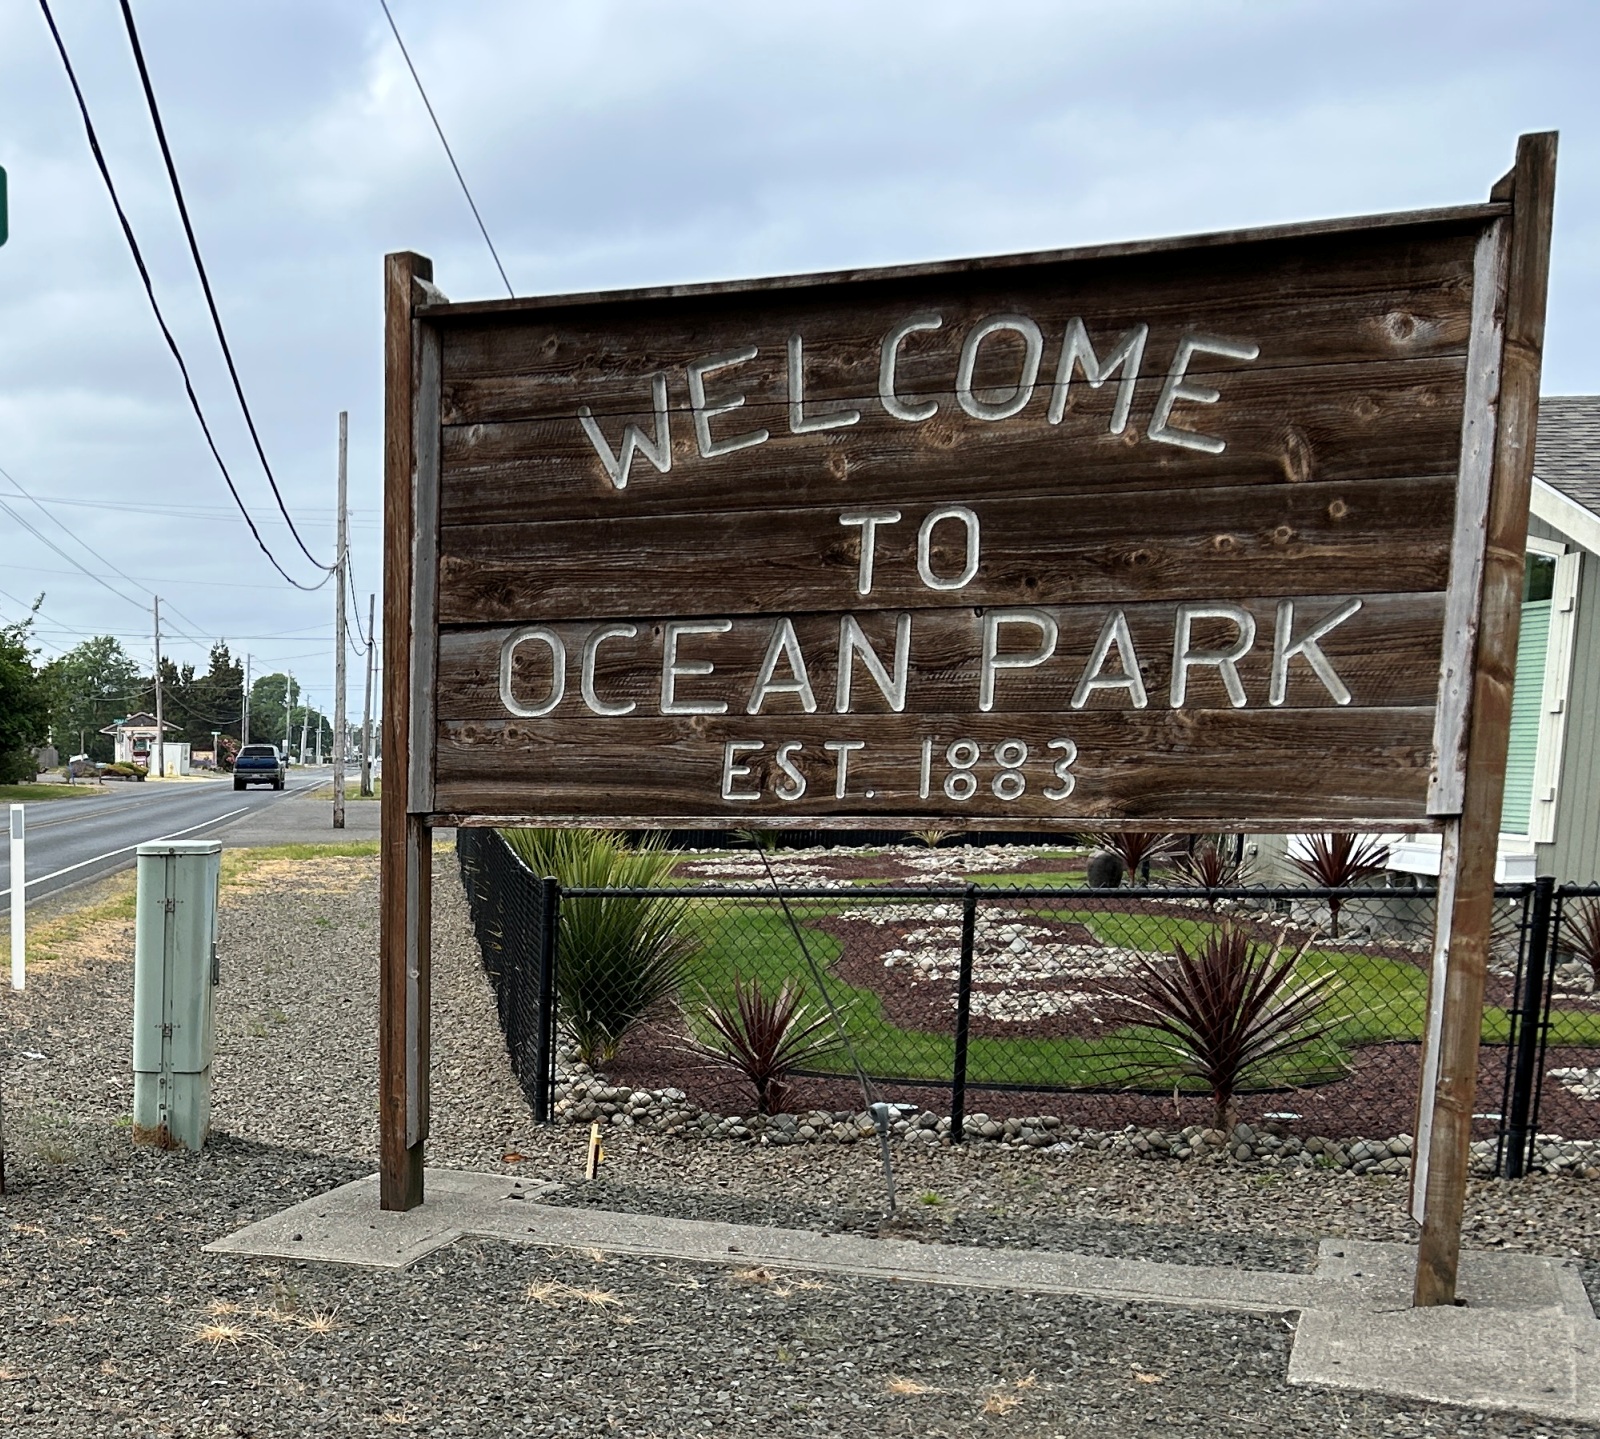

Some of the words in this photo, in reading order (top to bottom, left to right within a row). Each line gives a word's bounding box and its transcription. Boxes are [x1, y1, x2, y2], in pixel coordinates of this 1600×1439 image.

[577, 312, 1261, 489] WELCOME
[838, 504, 980, 594] TO
[498, 611, 912, 718] OCEAN
[978, 598, 1364, 712] PARK
[720, 739, 875, 802] EST.
[919, 736, 1078, 802] 1883
